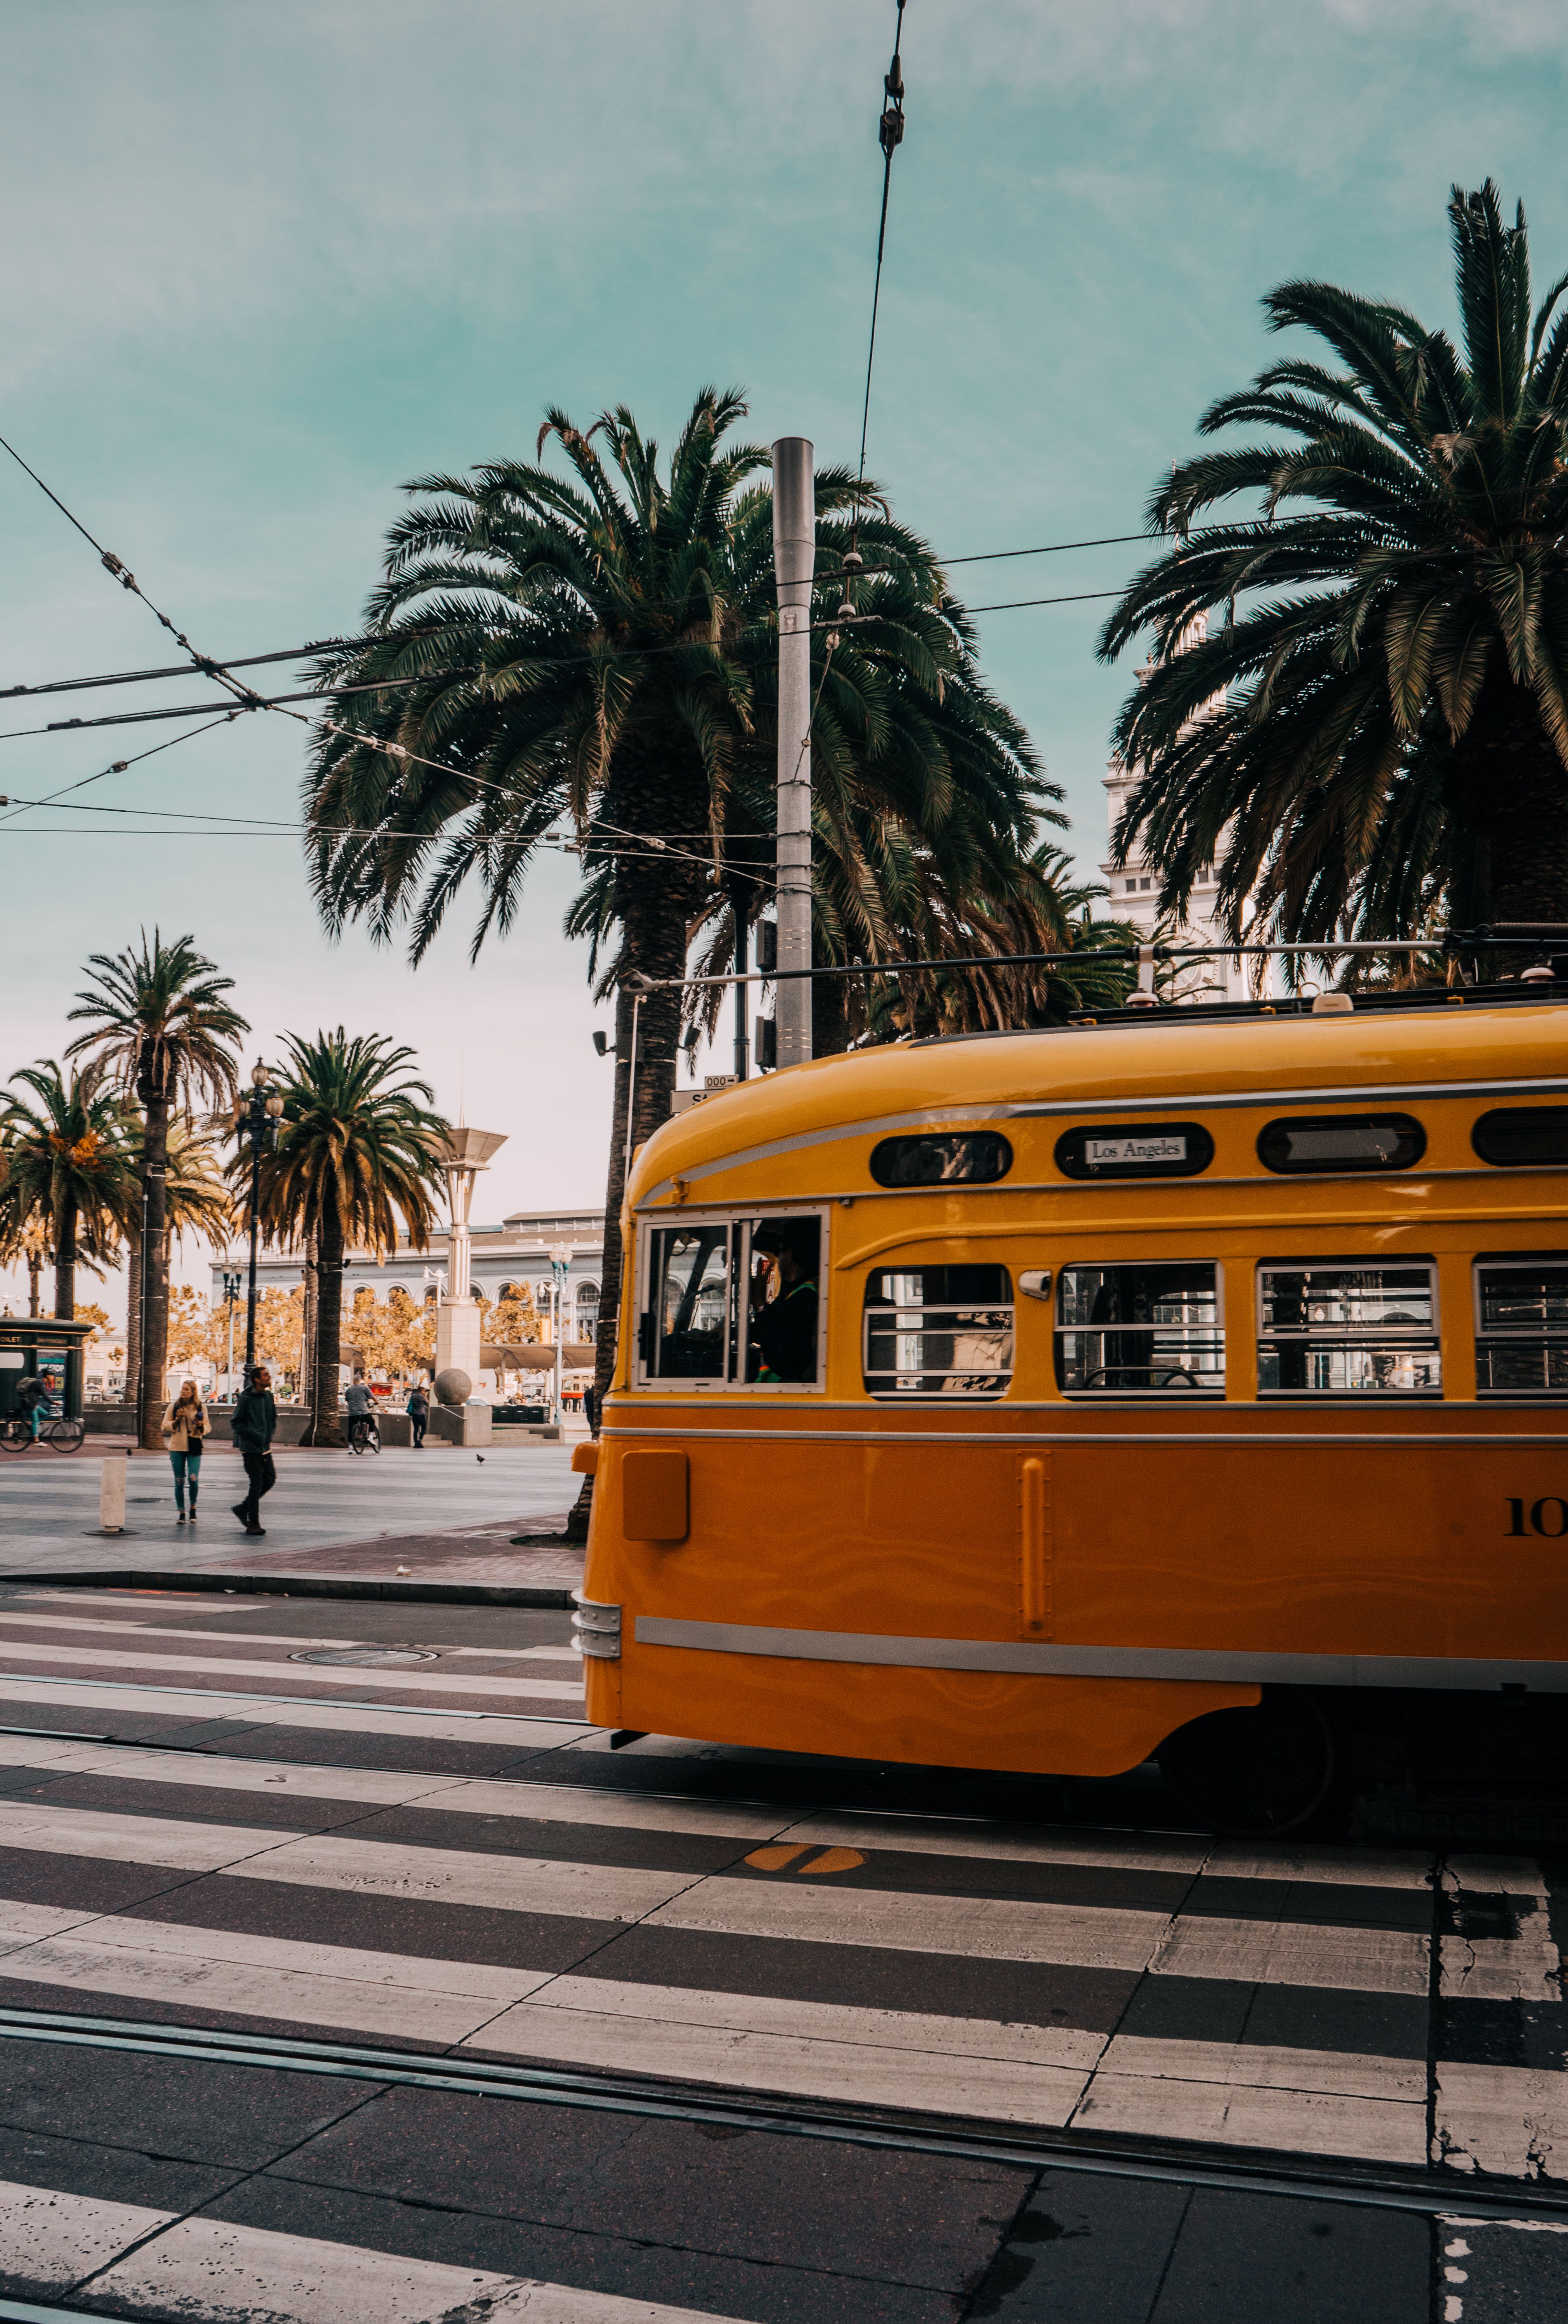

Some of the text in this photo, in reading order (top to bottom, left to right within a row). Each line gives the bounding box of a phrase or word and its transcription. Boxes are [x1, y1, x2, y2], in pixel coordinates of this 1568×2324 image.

[707, 1077, 726, 1086] 000
[1092, 1139, 1180, 1159] Los Angeles
[1502, 1497, 1568, 1538] 10
